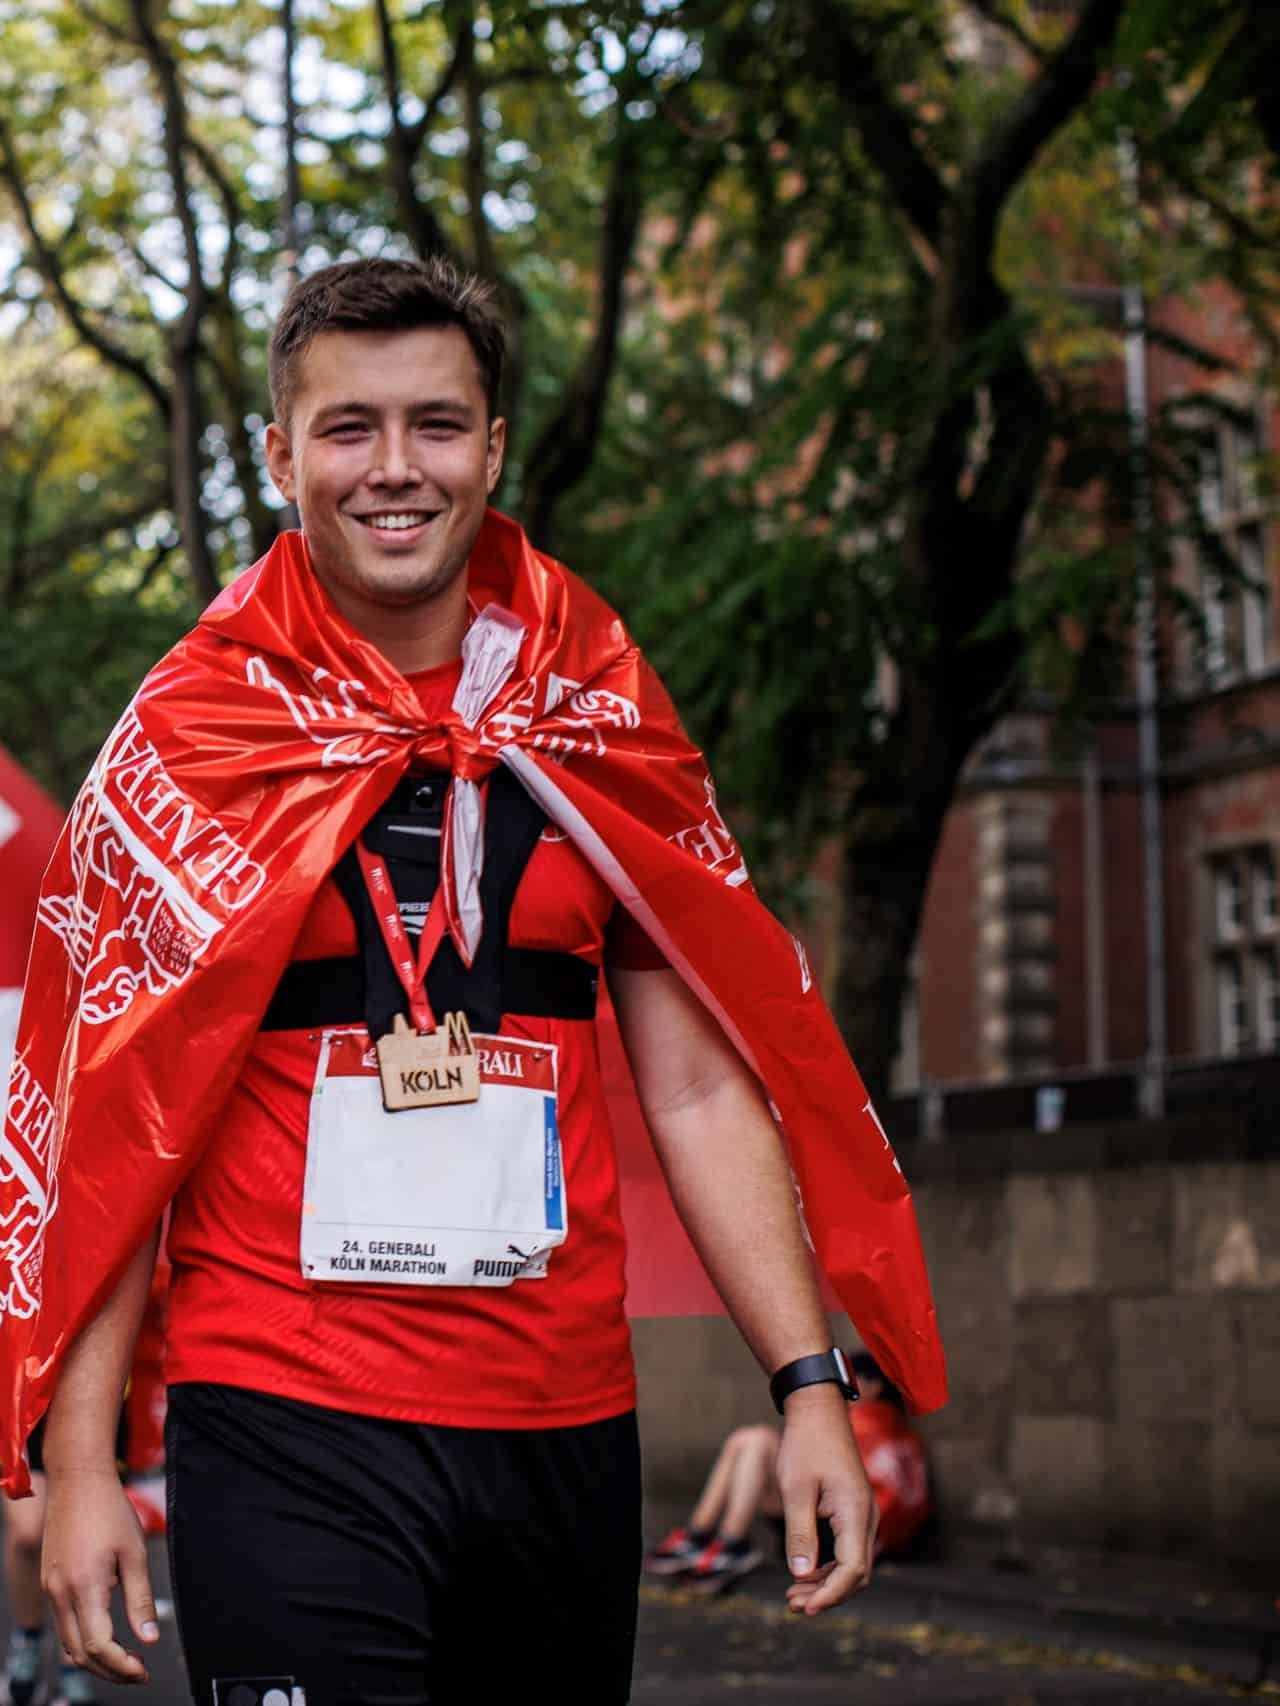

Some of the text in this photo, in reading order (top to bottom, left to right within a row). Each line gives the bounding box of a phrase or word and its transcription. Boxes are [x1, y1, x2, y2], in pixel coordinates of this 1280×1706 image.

[342, 1240, 436, 1257] 24. GENERALI
[330, 1255, 446, 1275] KÖLN MARATHON
